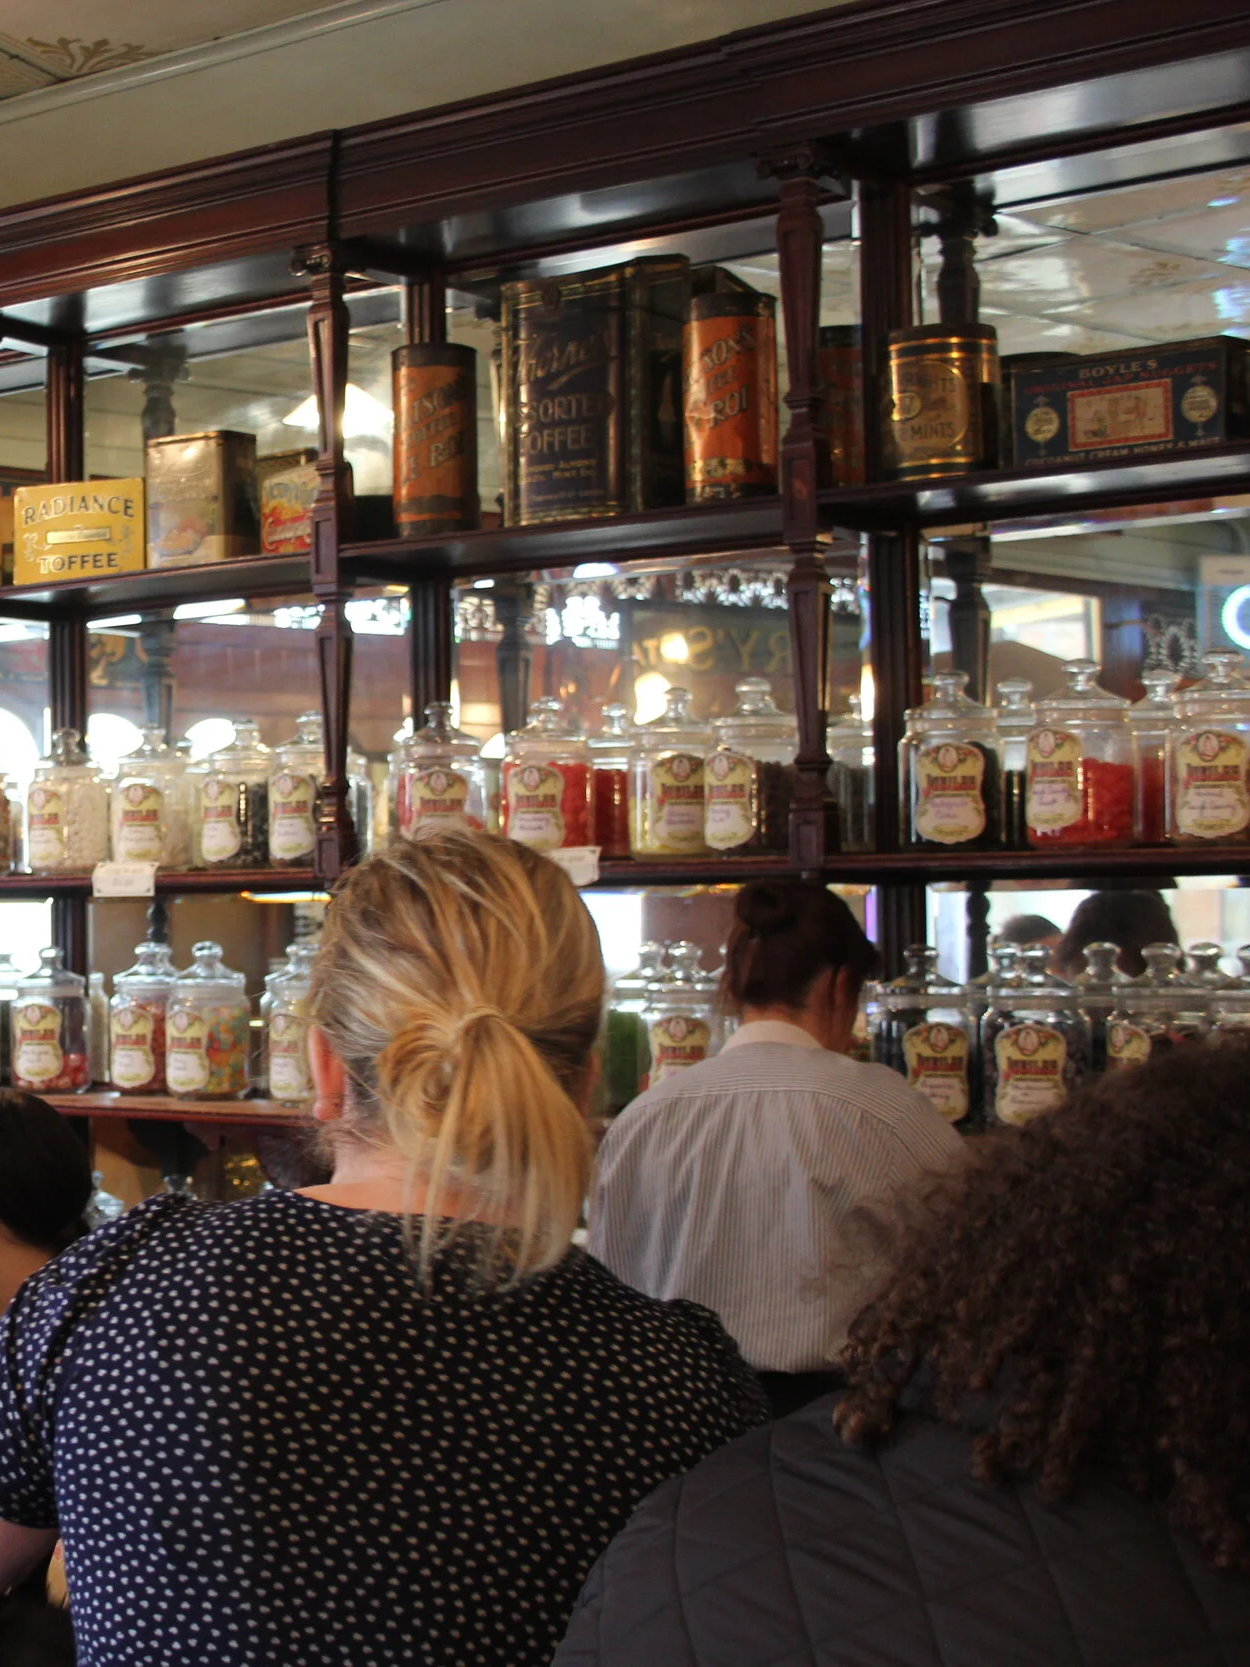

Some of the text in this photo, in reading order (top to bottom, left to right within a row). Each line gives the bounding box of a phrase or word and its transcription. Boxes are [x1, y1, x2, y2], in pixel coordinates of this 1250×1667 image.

[1078, 359, 1159, 379] BOYLE'S
[23, 494, 134, 527] RADIANCE
[37, 552, 118, 574] TOFFEE
